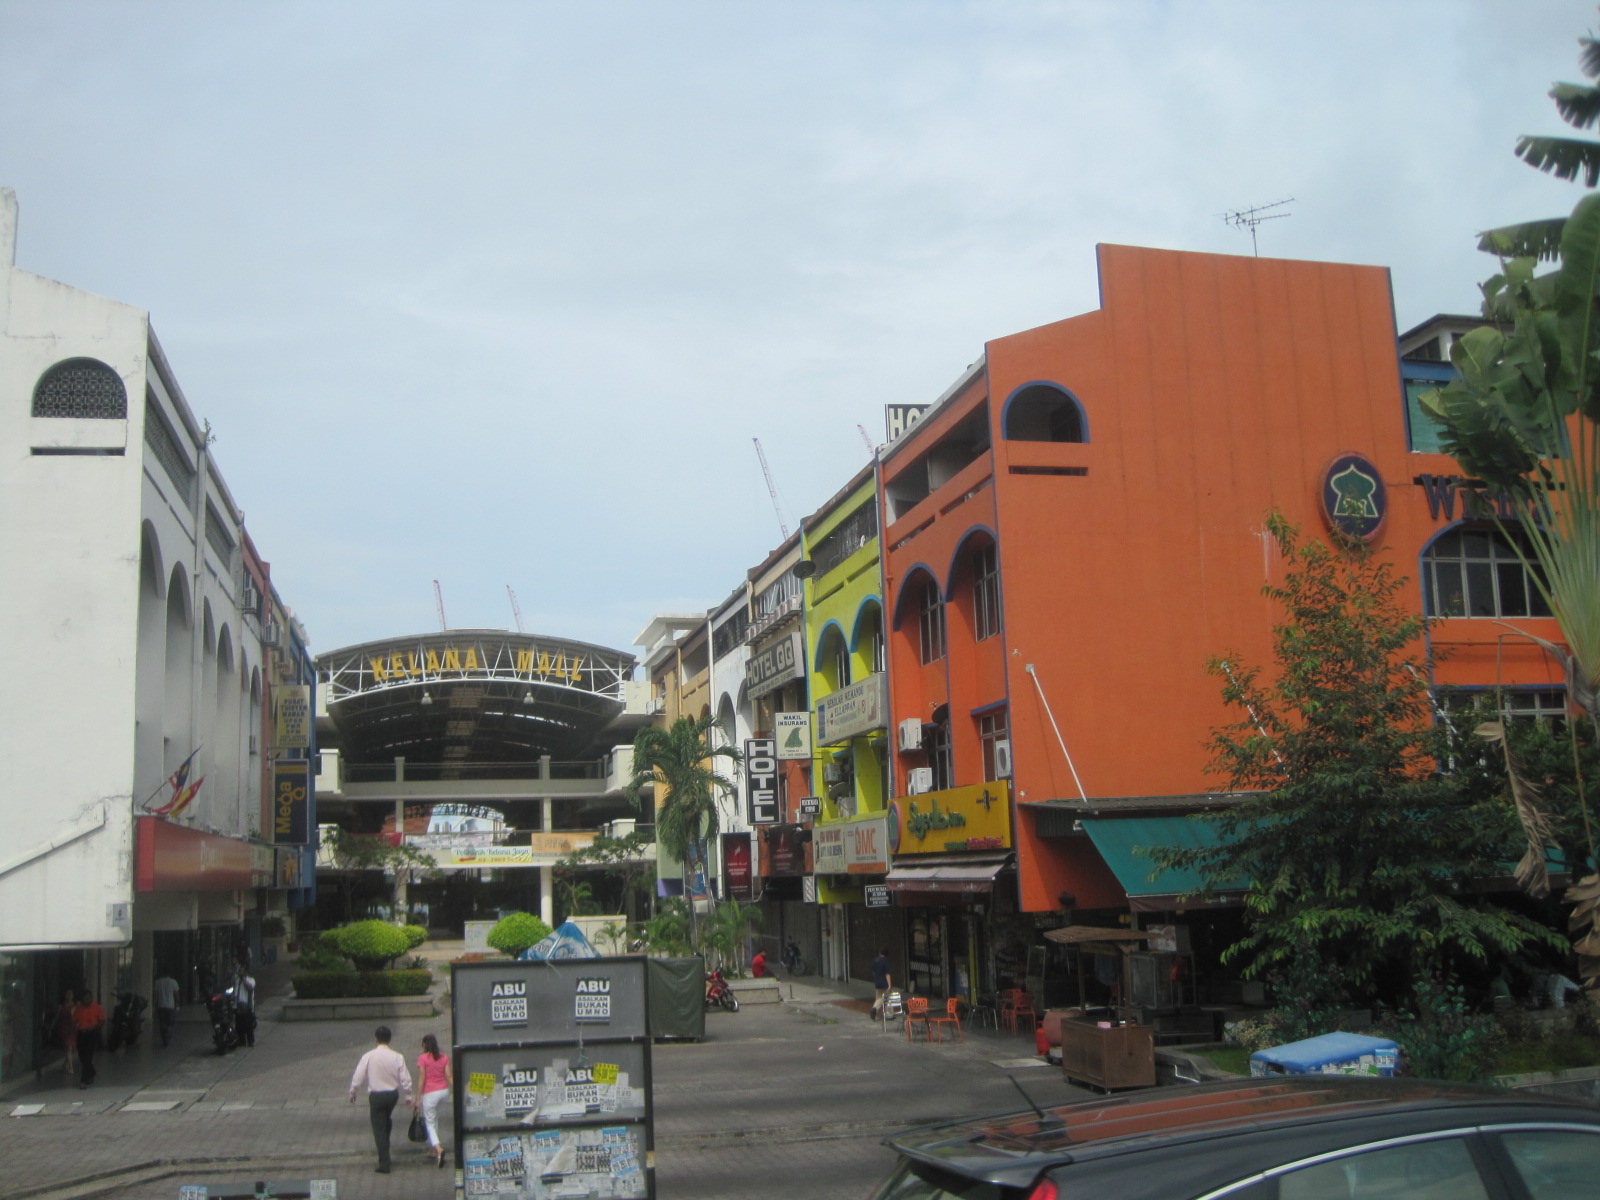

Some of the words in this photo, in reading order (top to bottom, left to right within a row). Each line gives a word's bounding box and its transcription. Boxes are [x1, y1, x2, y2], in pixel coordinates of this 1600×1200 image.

[888, 407, 930, 441] HO
[371, 647, 479, 682] KELANA
[516, 648, 582, 682] MALL
[746, 651, 777, 687] HOTEL
[748, 741, 776, 822] HOTEL
[492, 983, 526, 997] ABU
[576, 980, 610, 993] ABU
[494, 1004, 525, 1012] BUKAN
[577, 1001, 609, 1009] BUKAN
[494, 1011, 525, 1019] UMNO
[577, 1008, 608, 1016] UMNO
[504, 1070, 537, 1084] ABU
[567, 1089, 598, 1099] BUKAN
